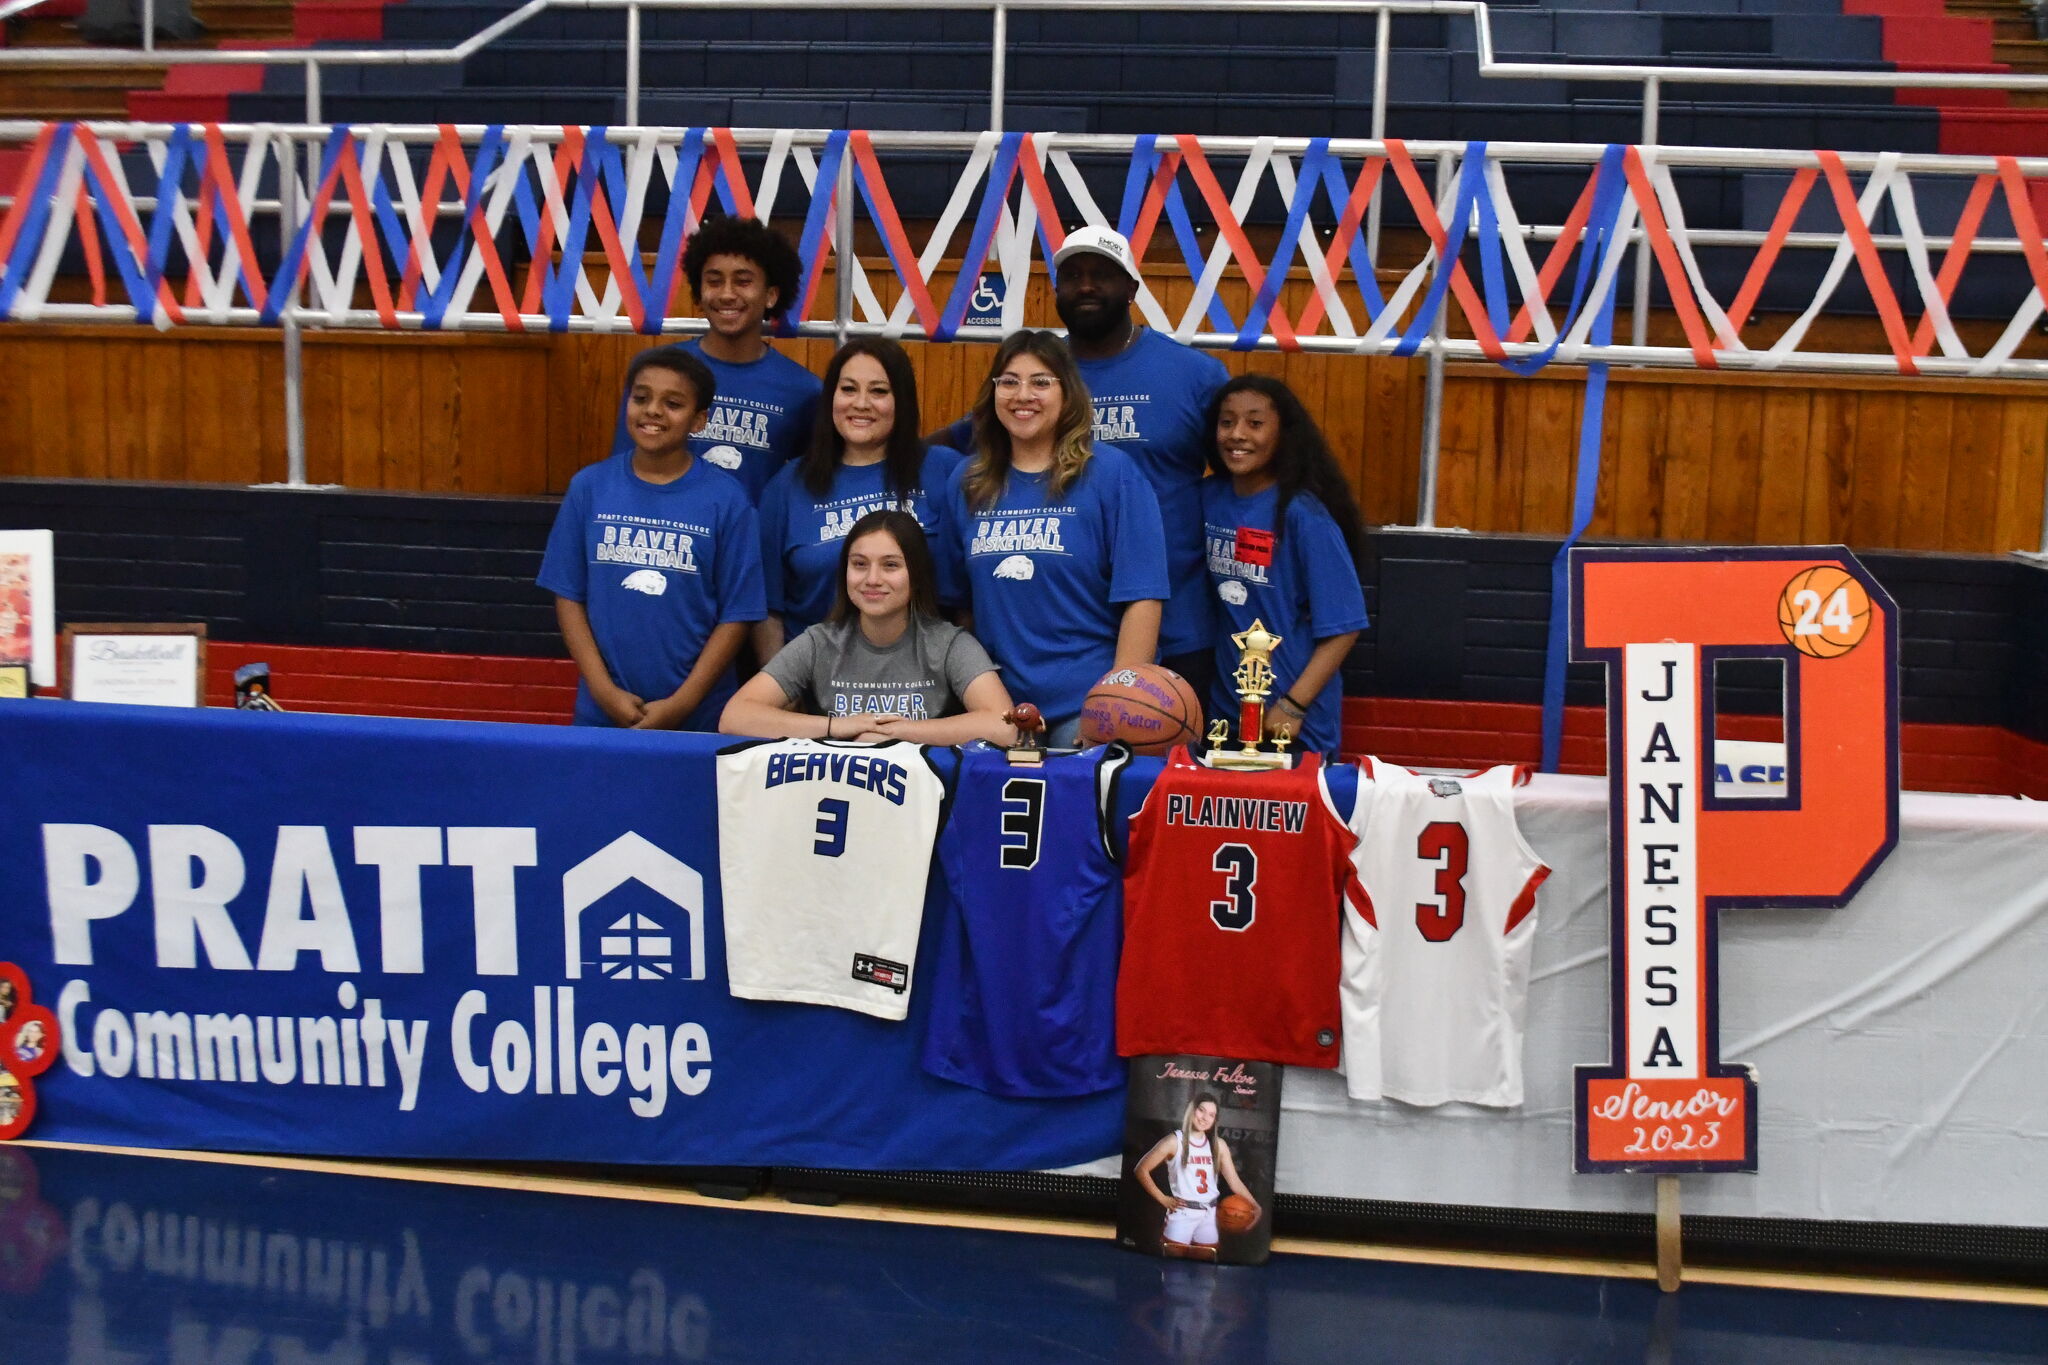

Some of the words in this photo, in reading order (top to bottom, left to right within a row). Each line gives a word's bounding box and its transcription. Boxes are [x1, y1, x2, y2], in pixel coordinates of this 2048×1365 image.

[966, 317, 1001, 325] ACCESSIB
[708, 406, 769, 432] AVER
[749, 401, 784, 413] COLLEGE
[1093, 406, 1135, 425] VER
[1091, 422, 1140, 441] TBALL
[623, 515, 671, 527] COMMUNITY
[672, 521, 710, 534] COLLEGE
[997, 508, 1040, 516] COMMUNITY
[603, 526, 694, 553] BEAVER
[977, 517, 1060, 538] BEAVER
[971, 533, 1065, 555] BASKETBALL
[597, 543, 697, 572] BASKETBALL
[1792, 587, 1853, 636] 24
[835, 693, 926, 713] BEAVER
[1118, 711, 1163, 731] Fulton
[1207, 719, 1229, 738] 20
[765, 752, 908, 807] BEAVERS
[1000, 777, 1047, 870] 3
[1166, 793, 1308, 834] PLAINVIEW
[813, 797, 850, 858] 3
[1640, 660, 1684, 1068] JANESSA
[1210, 842, 1258, 933] 3
[1416, 820, 1470, 943] 3
[42, 823, 538, 976] PRATT
[58, 979, 430, 1111] Community
[451, 985, 712, 1118] College
[1156, 1062, 1210, 1081] Janessa
[1213, 1063, 1257, 1085] Fulton
[1593, 1083, 1738, 1121] Senior
[1623, 1121, 1722, 1153] 2023
[1195, 1169, 1208, 1194] 3
